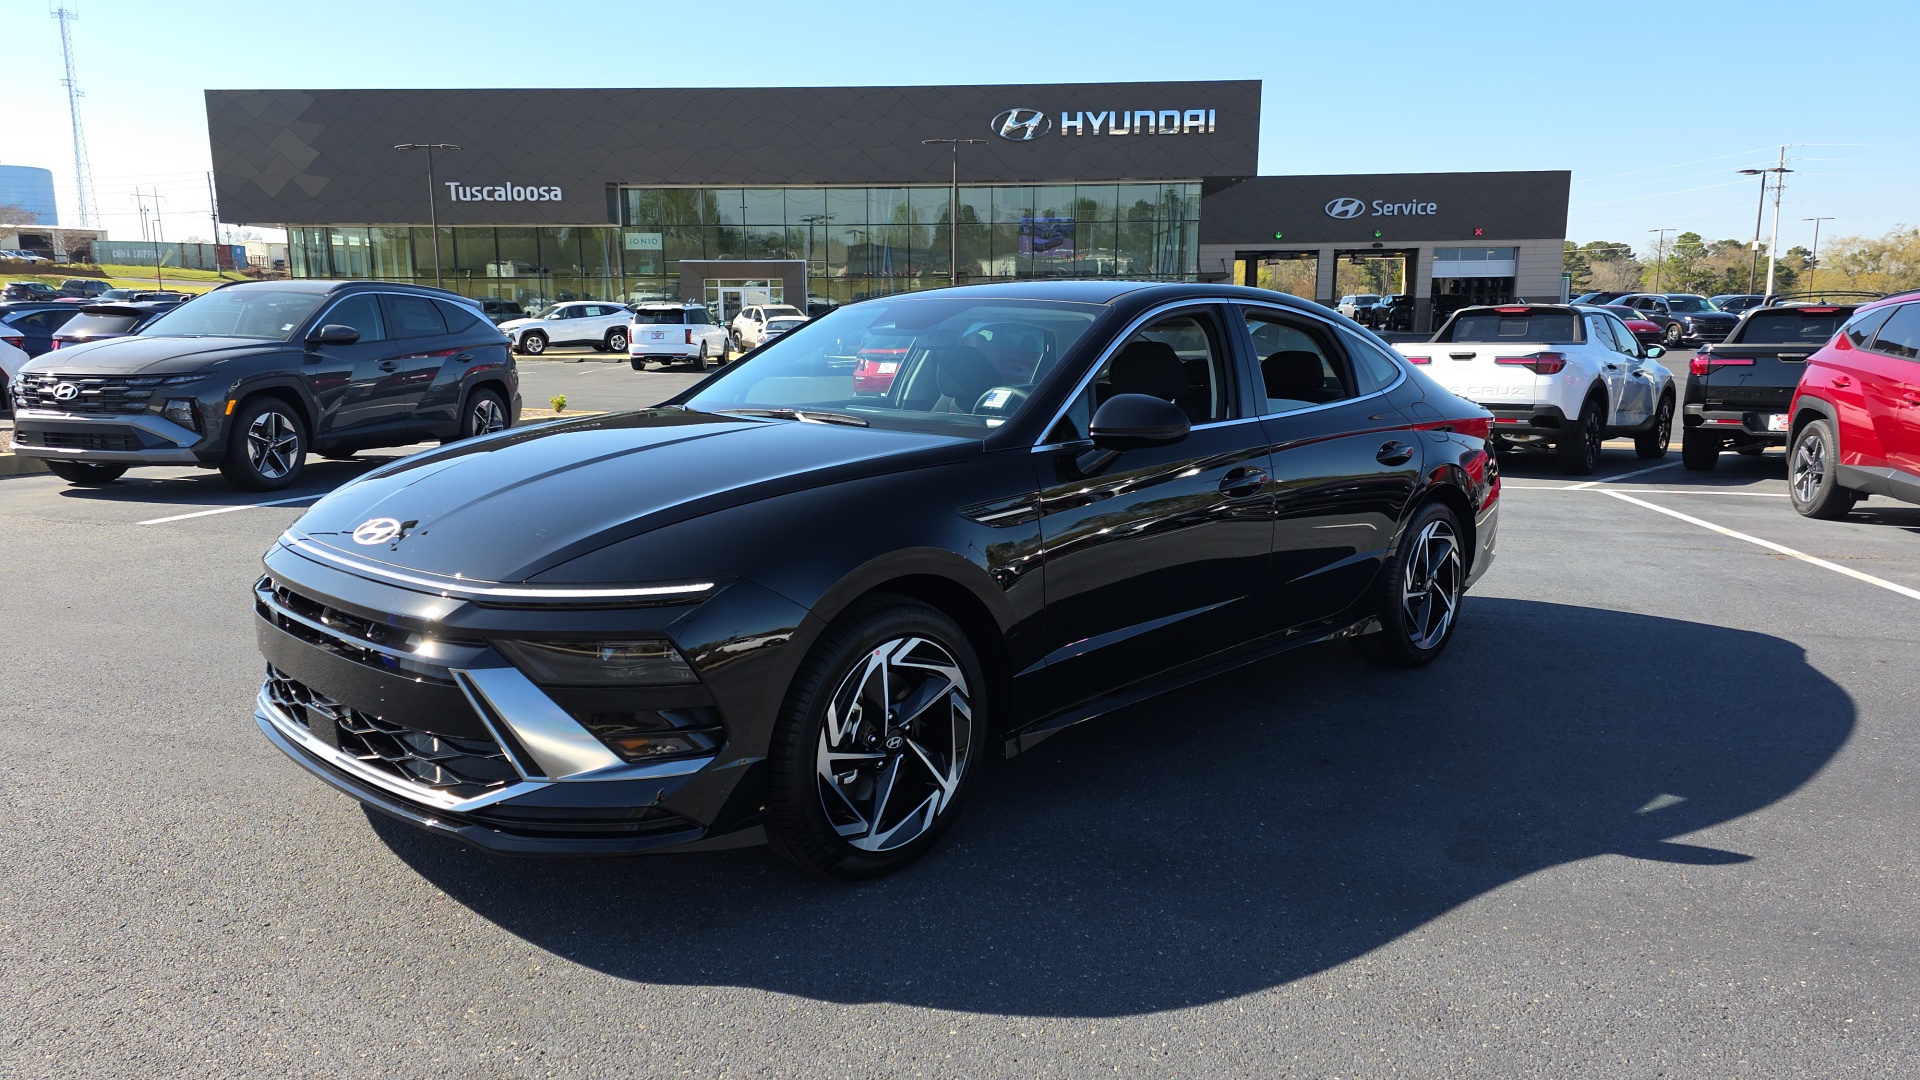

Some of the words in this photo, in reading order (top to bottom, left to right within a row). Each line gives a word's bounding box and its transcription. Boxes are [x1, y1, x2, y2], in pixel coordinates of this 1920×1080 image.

[1061, 109, 1216, 136] HYUNDAI
[444, 181, 563, 202] Tuscaloosa
[1371, 199, 1437, 216] Service
[112, 249, 131, 258] CHINA
[1467, 386, 1526, 396] CRUZ
